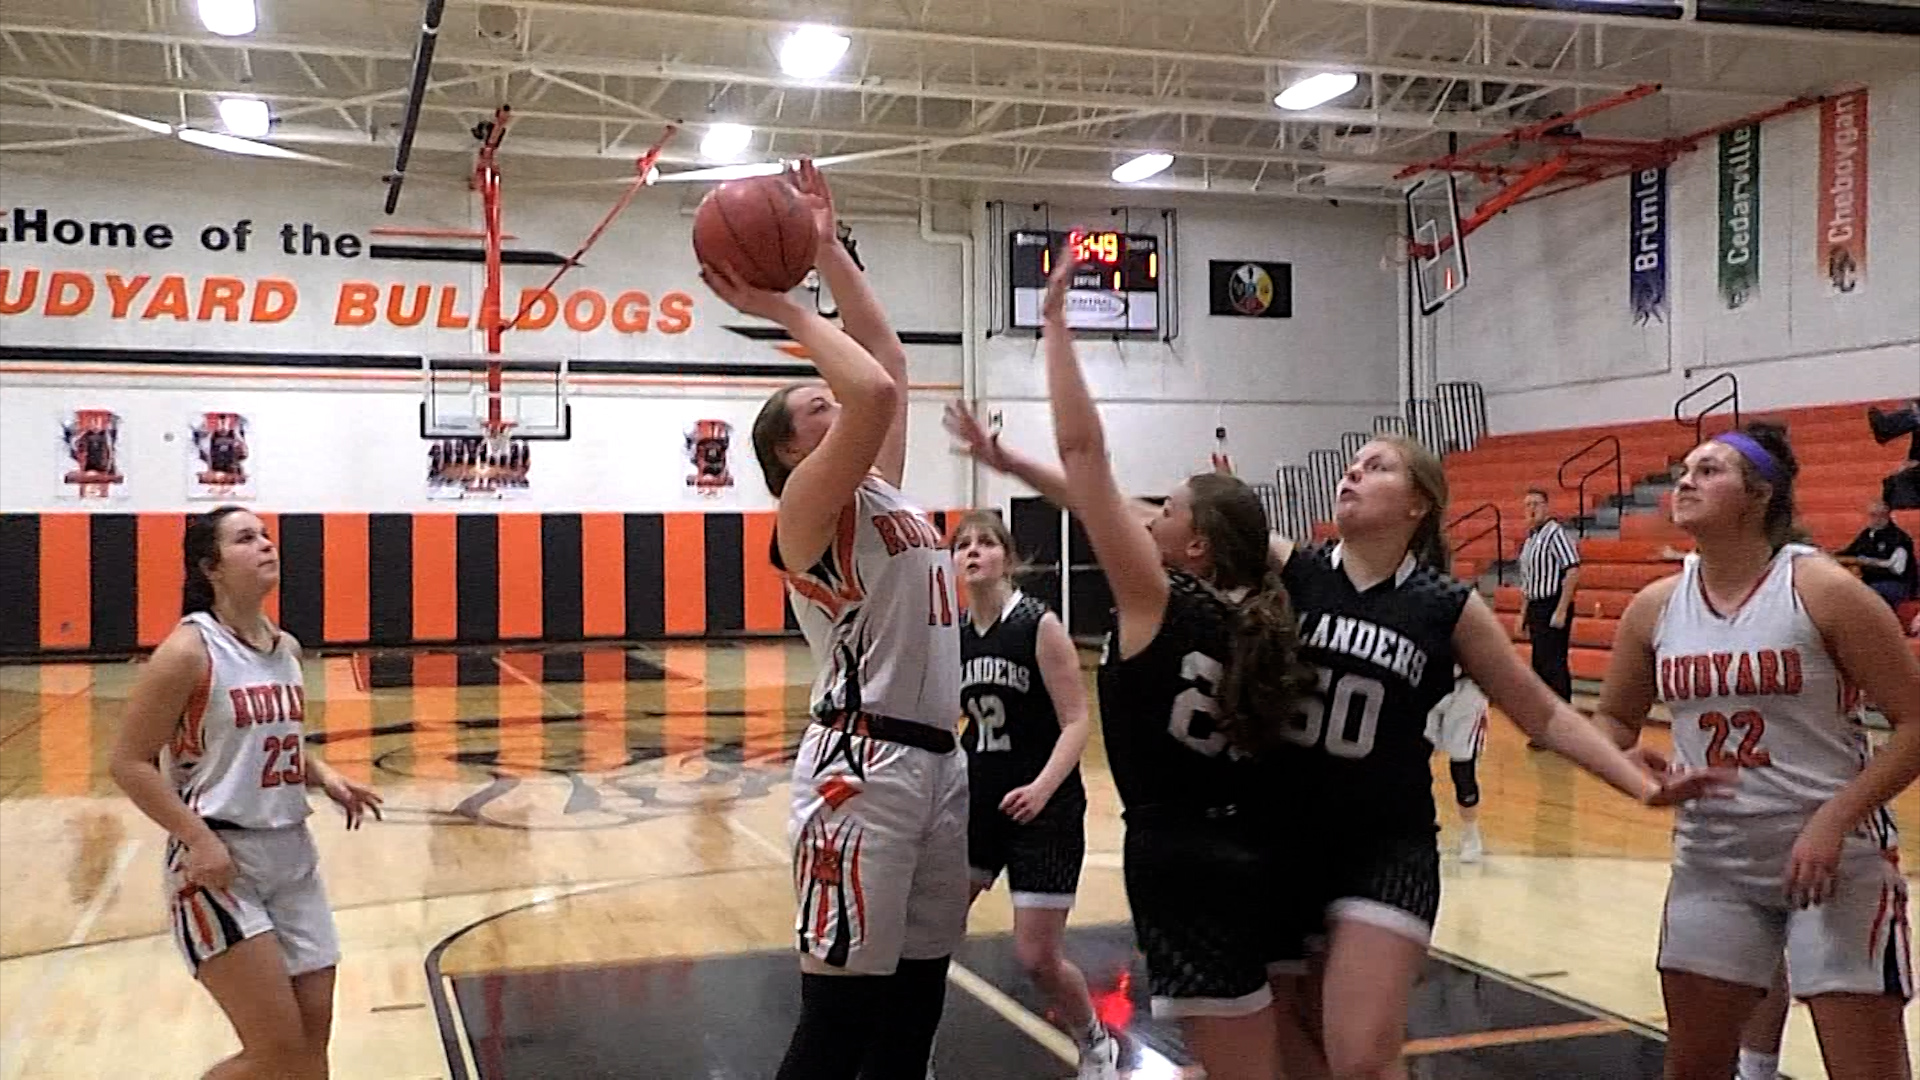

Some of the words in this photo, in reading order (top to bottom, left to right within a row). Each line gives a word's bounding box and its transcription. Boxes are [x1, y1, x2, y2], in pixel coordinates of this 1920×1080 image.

[1727, 125, 1751, 264] Cedarville
[1828, 96, 1859, 242] Cheboygan
[13, 207, 174, 250] Home
[200, 219, 251, 251] of
[281, 223, 362, 258] the
[927, 565, 952, 627] 11
[1661, 648, 1803, 700] RUDYARD
[967, 694, 1012, 753] 12
[1698, 709, 1772, 768] 22
[261, 733, 305, 788] 23
